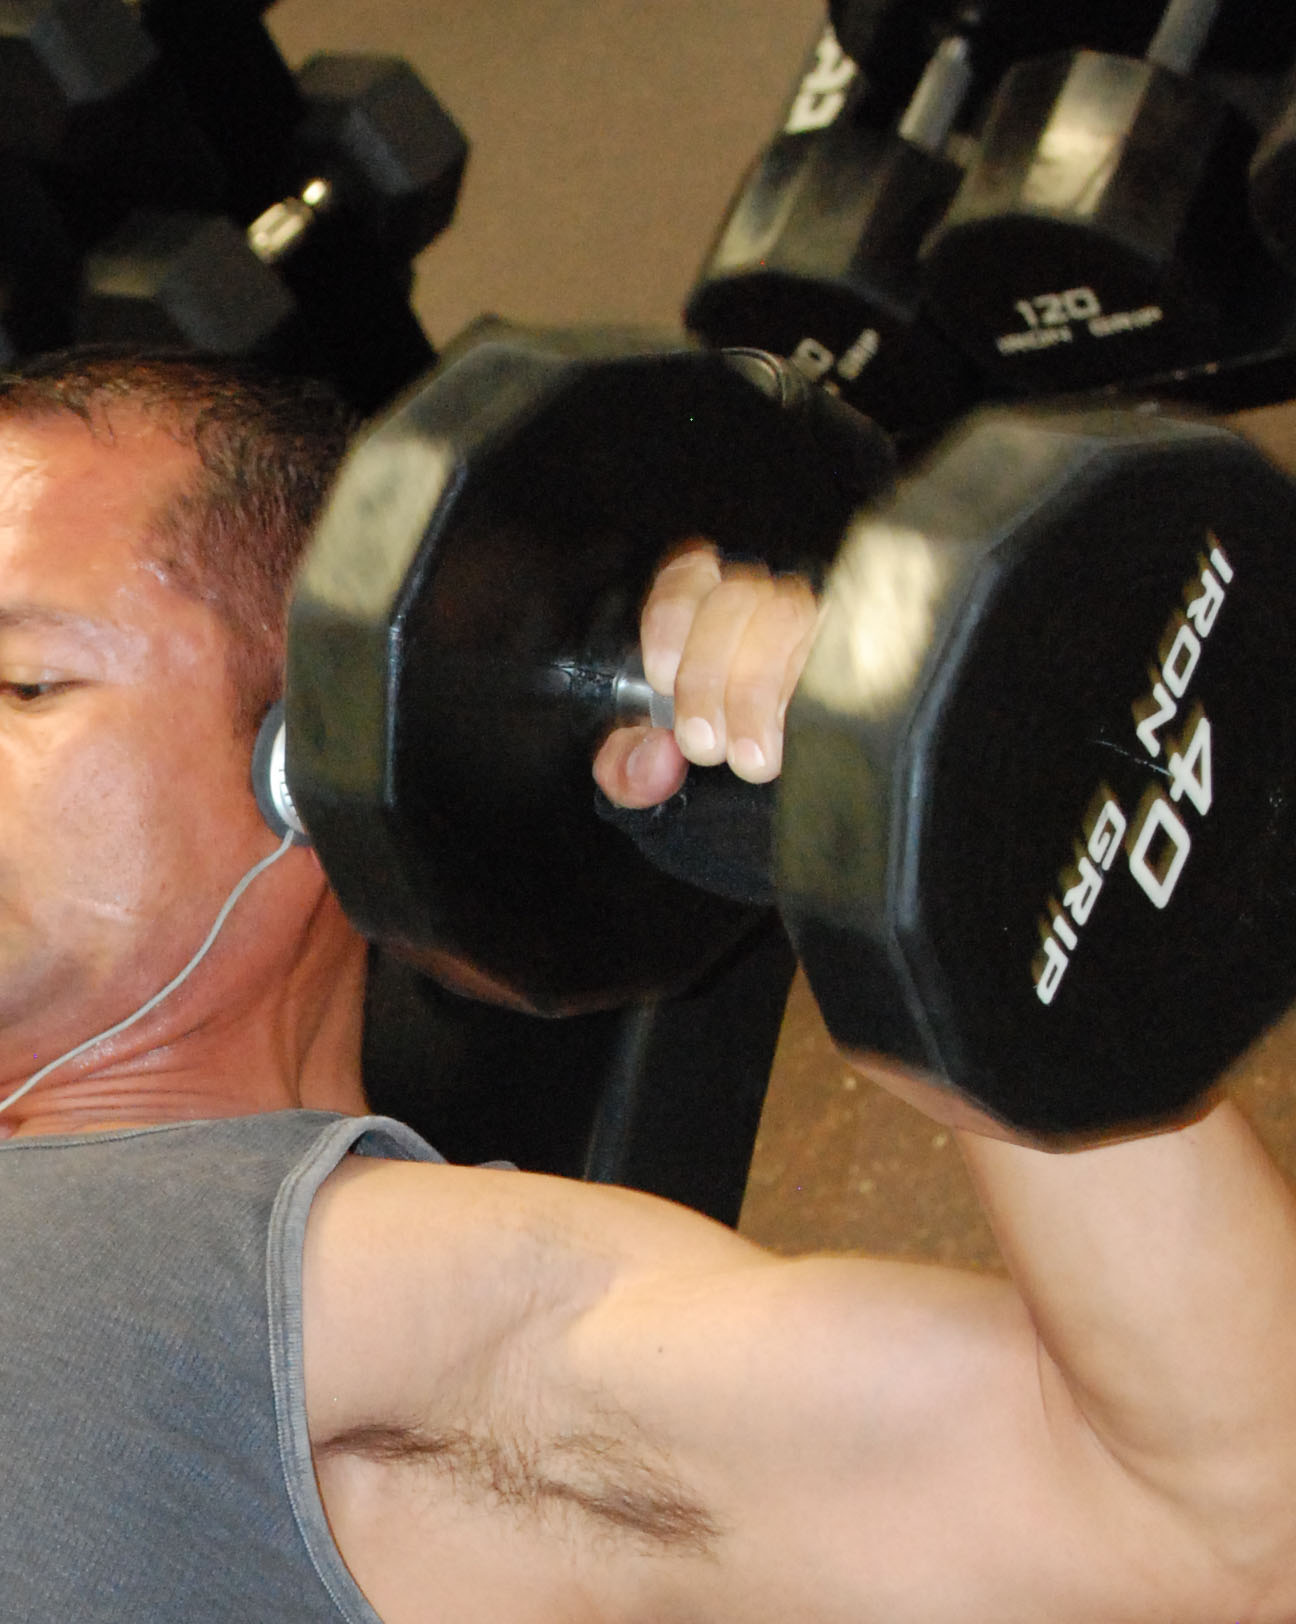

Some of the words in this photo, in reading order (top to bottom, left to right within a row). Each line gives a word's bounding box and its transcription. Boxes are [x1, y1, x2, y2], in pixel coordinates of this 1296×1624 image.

[1016, 286, 1101, 326] 120
[1136, 547, 1234, 758] IRON
[1036, 799, 1127, 1005] GRIP
[1129, 717, 1212, 909] 40
